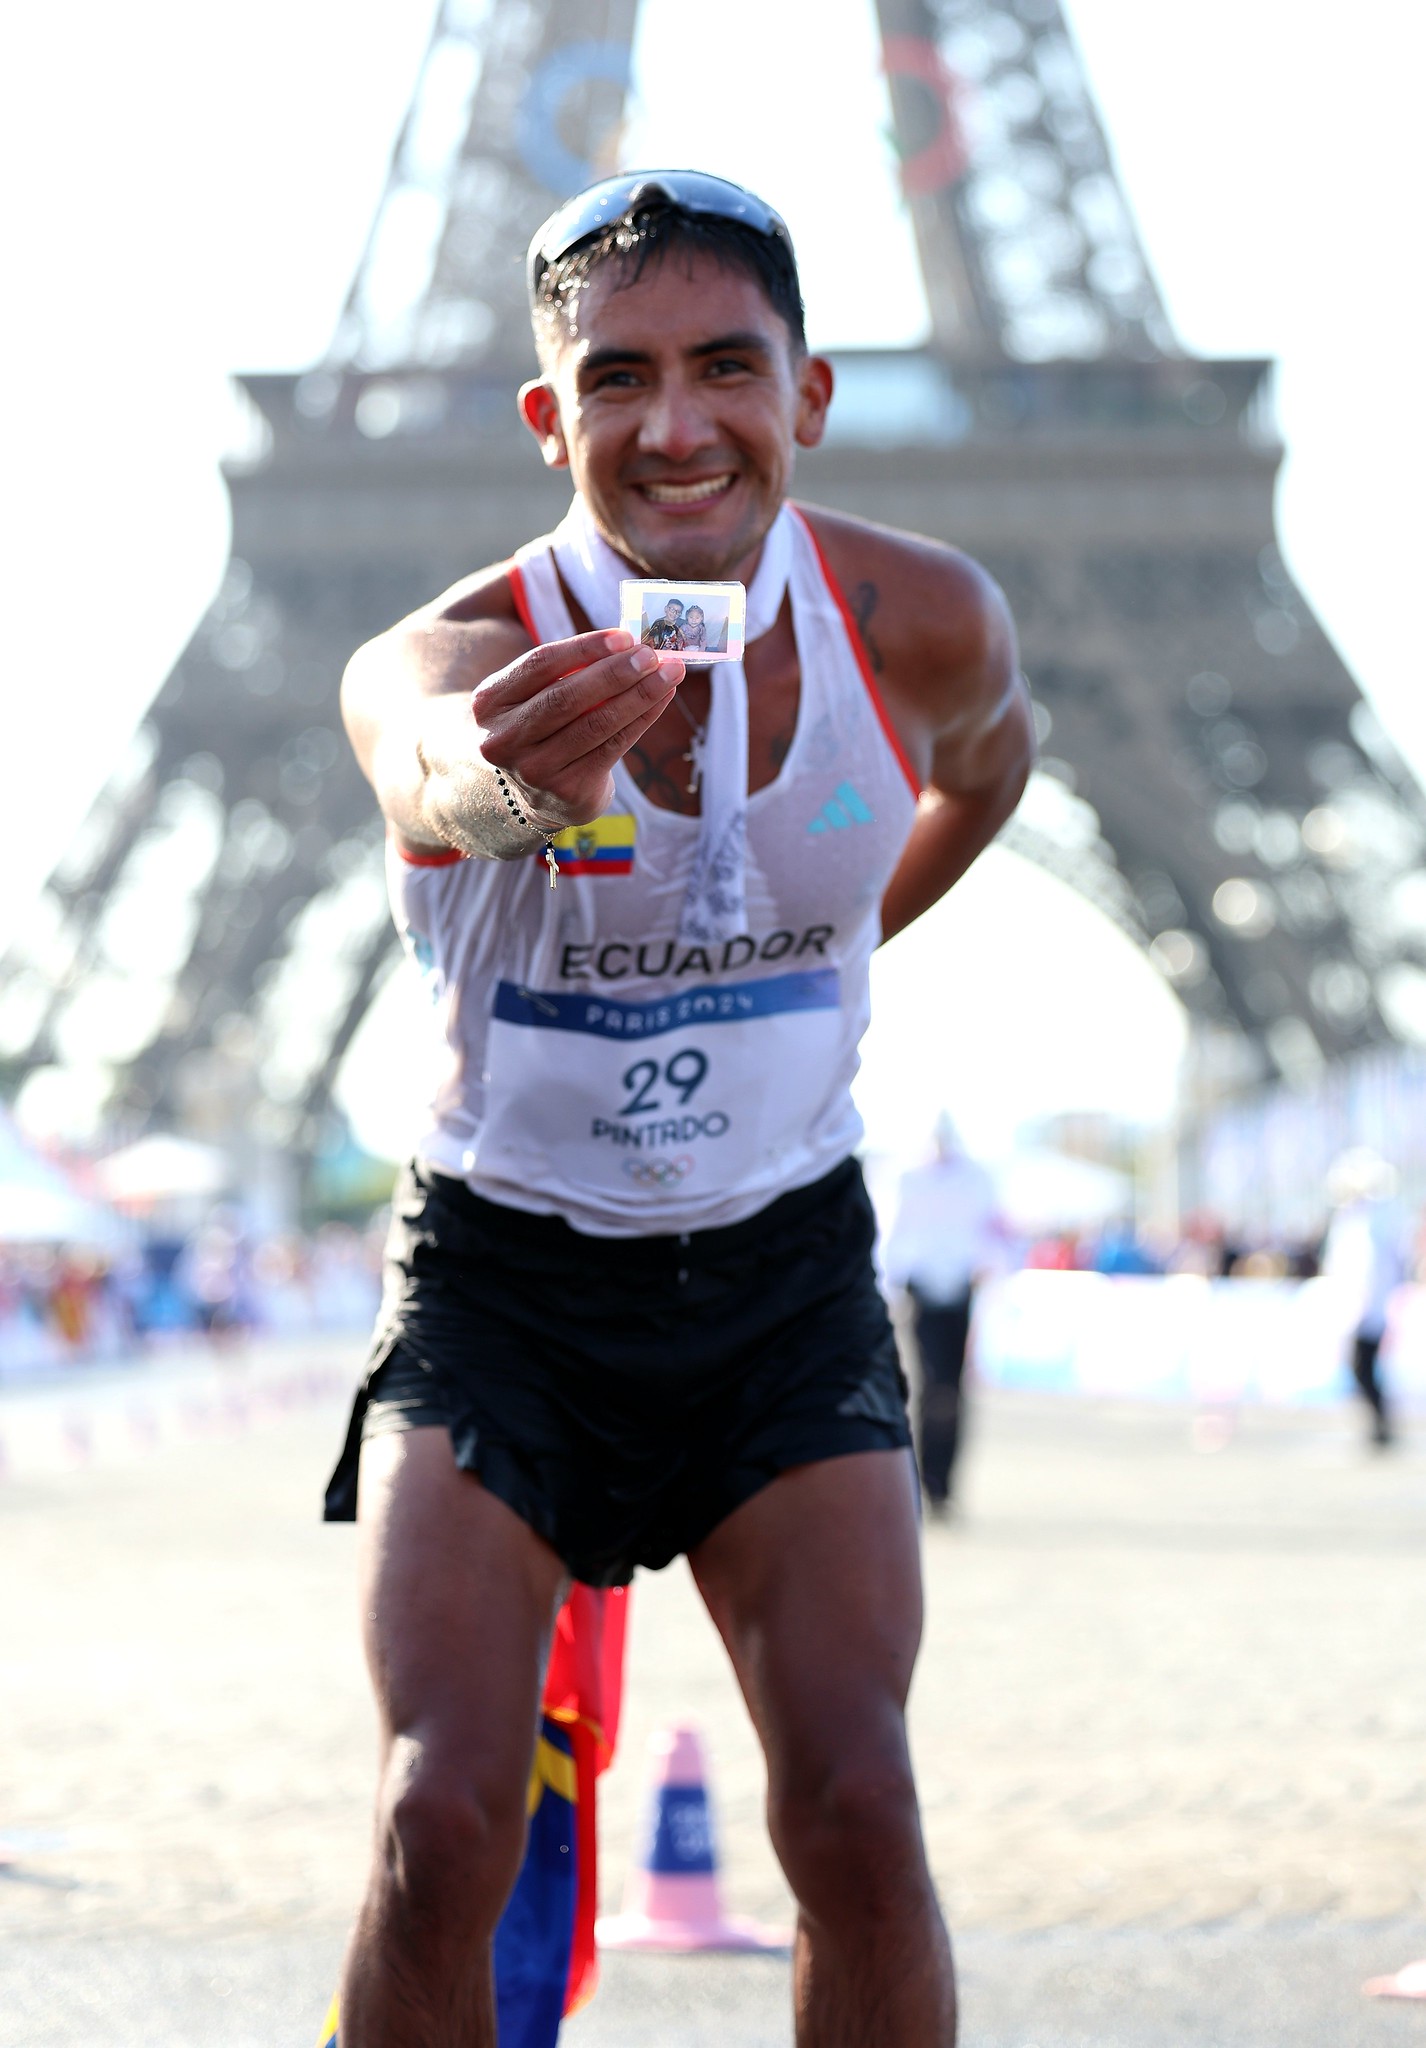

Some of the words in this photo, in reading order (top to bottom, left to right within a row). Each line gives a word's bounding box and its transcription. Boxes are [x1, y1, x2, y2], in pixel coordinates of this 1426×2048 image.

[560, 924, 834, 979] ECUADOR
[585, 1004, 671, 1033] PARIS
[620, 1048, 709, 1116] 29
[592, 1111, 730, 1149] PINTADO
